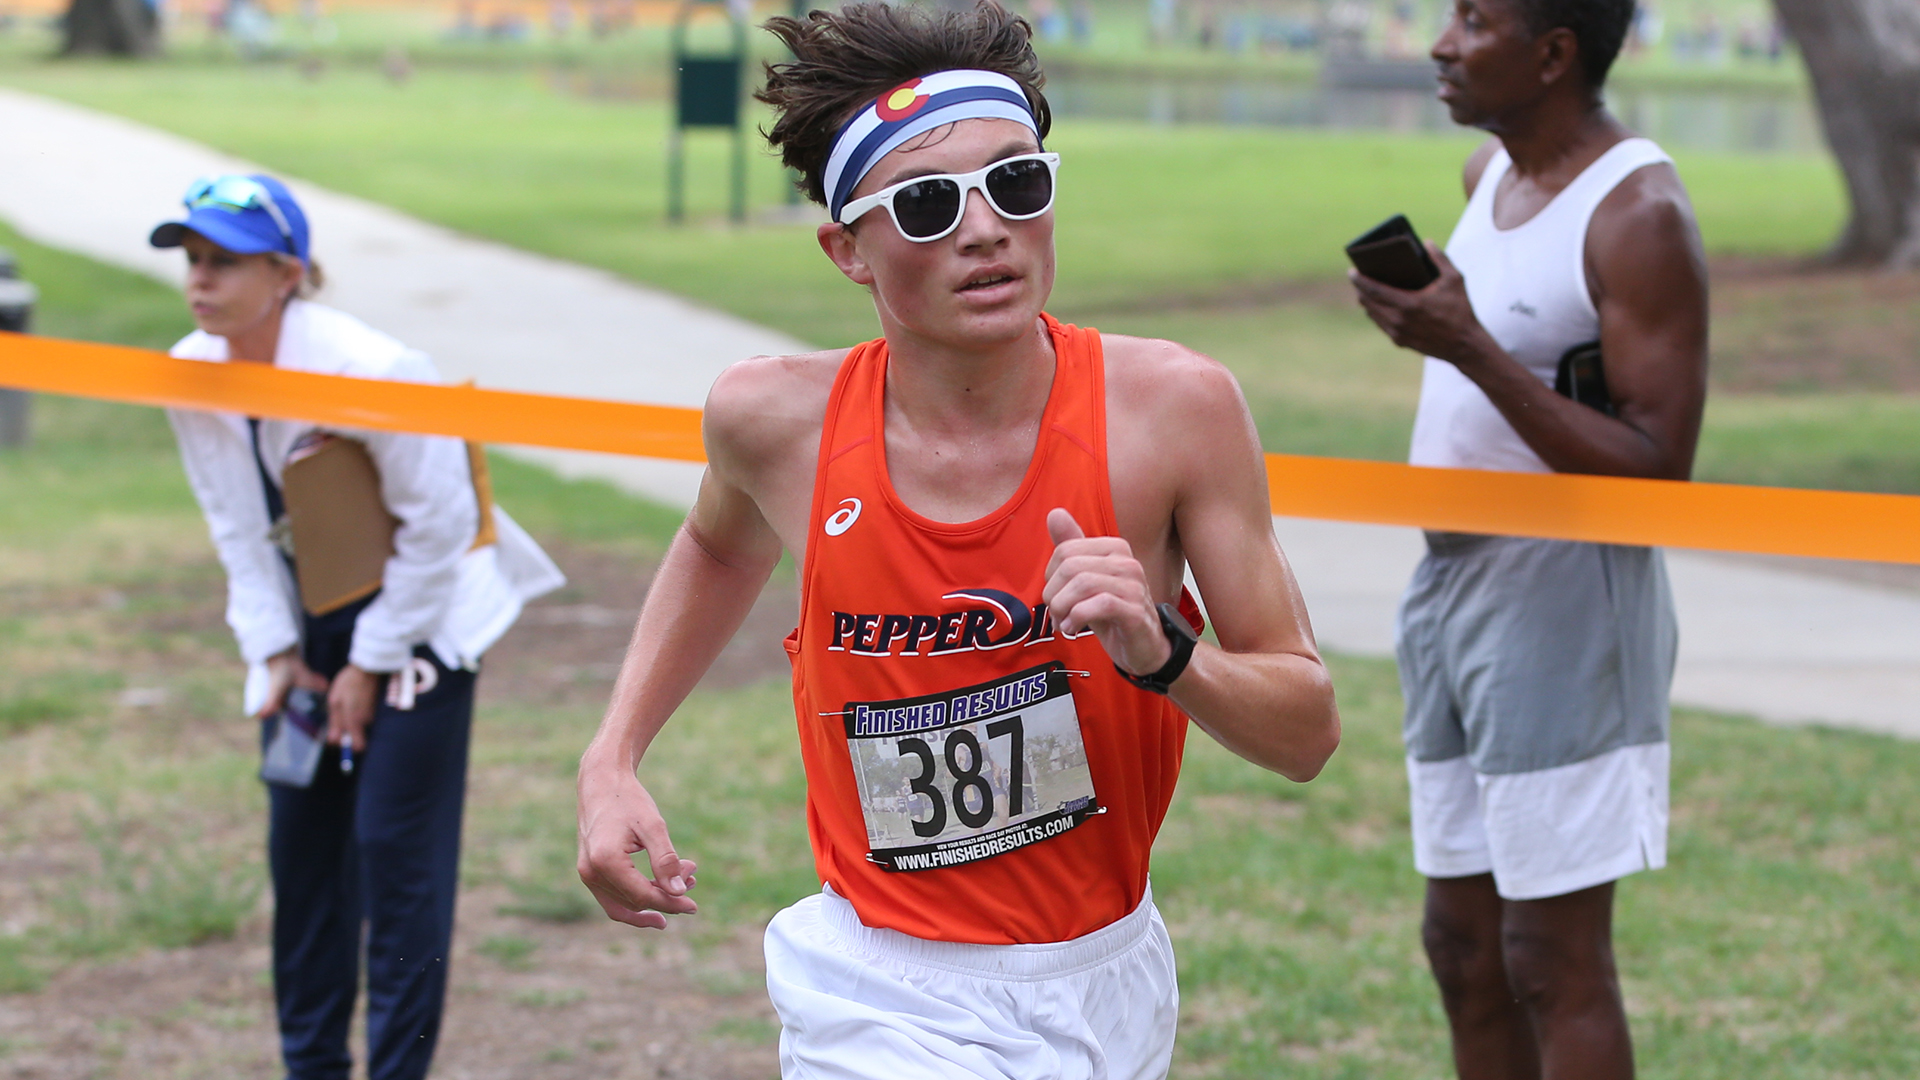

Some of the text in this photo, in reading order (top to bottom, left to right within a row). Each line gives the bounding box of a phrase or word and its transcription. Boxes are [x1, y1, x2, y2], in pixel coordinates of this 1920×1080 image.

[828, 588, 1094, 657] PEPPERDI
[855, 671, 1048, 735] FINISHED RESULTS
[898, 715, 1025, 838] 387
[894, 815, 1075, 871] WWW.FINISHEDRESULTS.COM
[959, 838, 976, 846] RESULTS
[986, 832, 997, 840] RACE
[1005, 825, 1021, 834] PHOTOS
